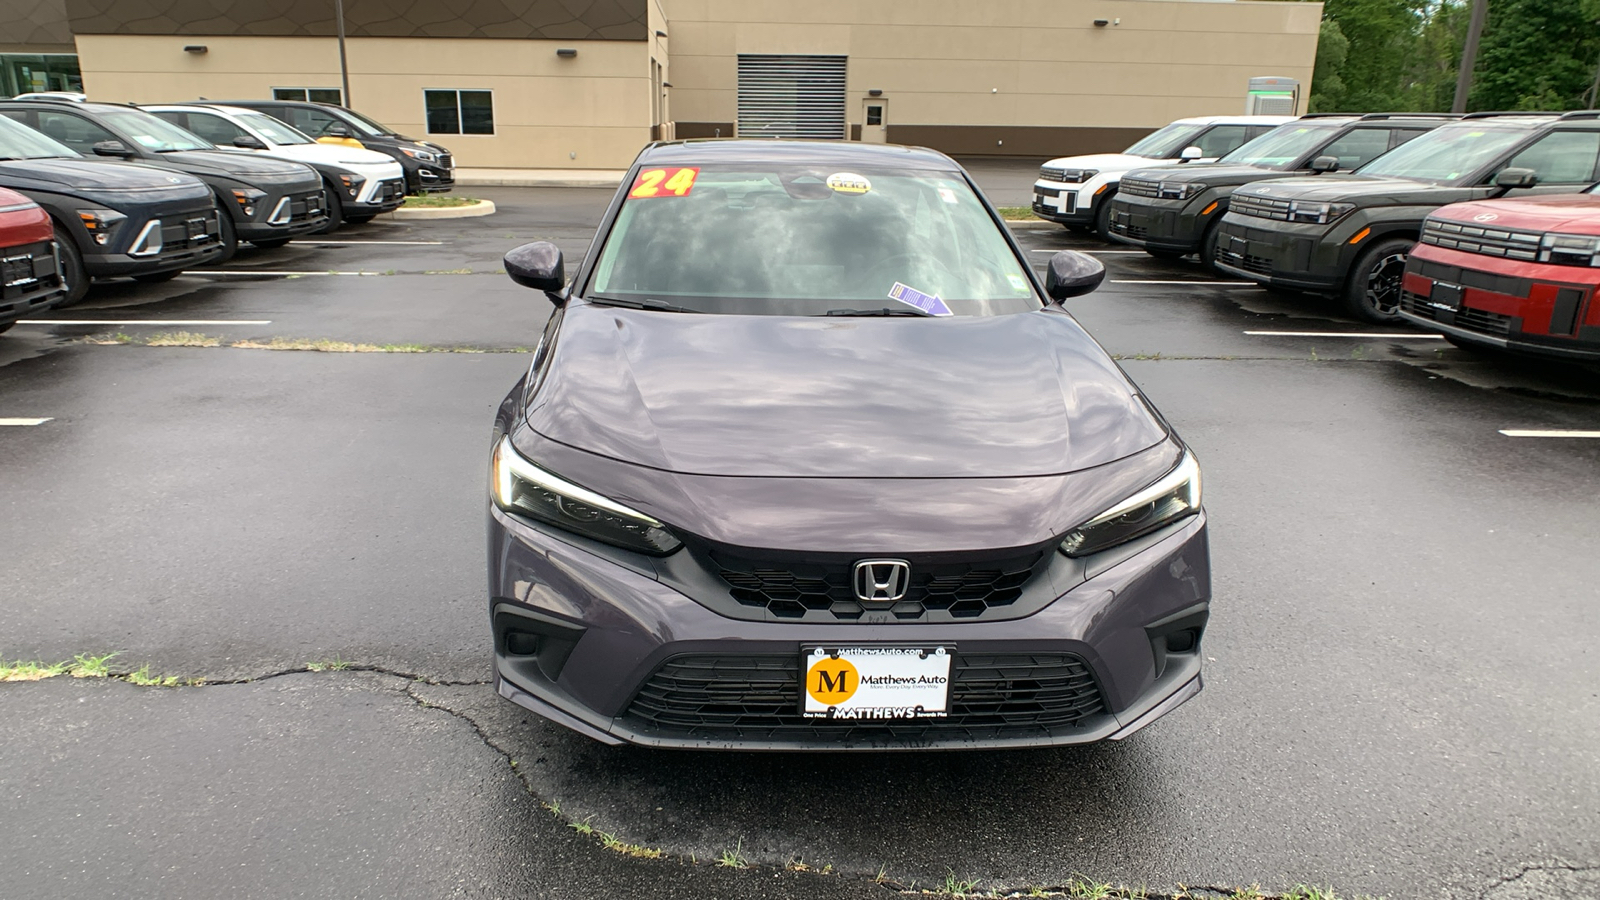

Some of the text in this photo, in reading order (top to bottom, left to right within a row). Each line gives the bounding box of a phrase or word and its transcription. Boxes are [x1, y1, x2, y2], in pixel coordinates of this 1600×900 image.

[631, 168, 696, 198] 24
[836, 648, 923, 656] MatthewsAuto.com
[814, 670, 849, 693] M
[860, 674, 947, 685] Matthews Auto
[832, 706, 915, 719] MATTHEWS
